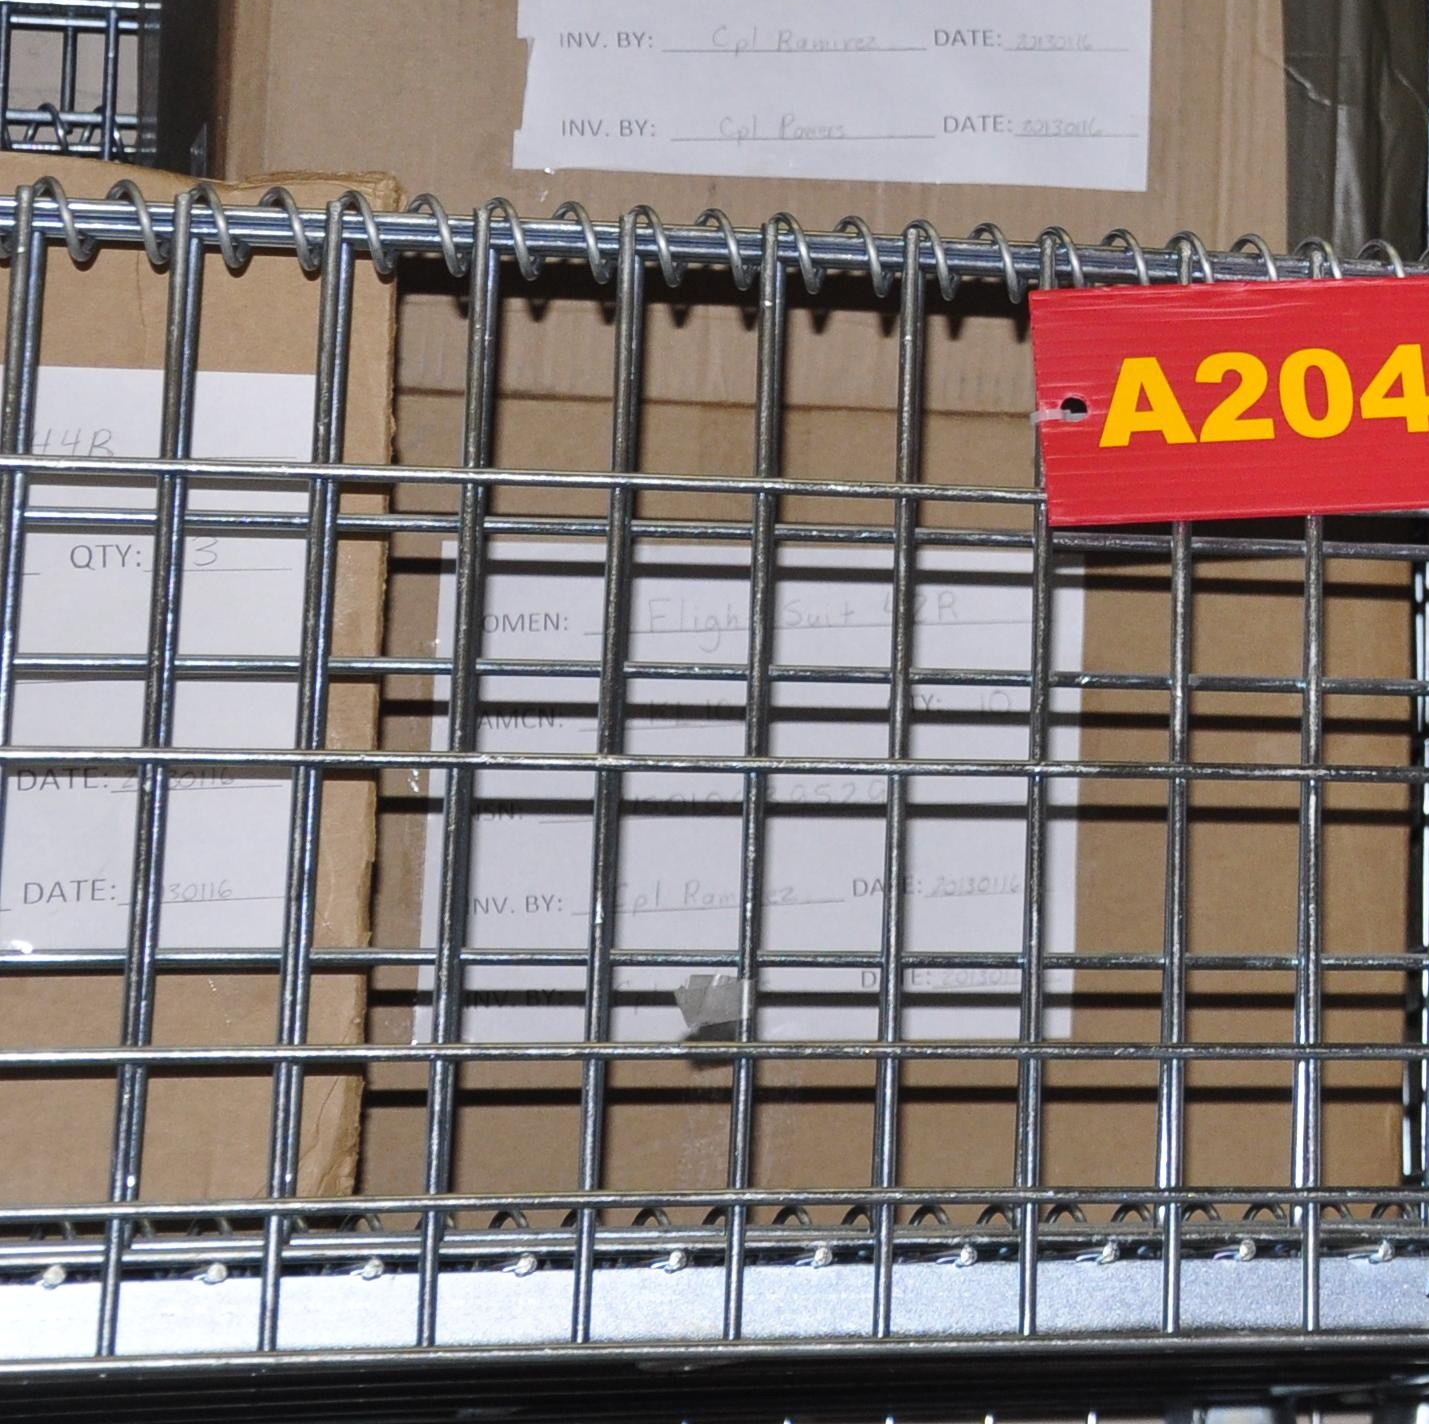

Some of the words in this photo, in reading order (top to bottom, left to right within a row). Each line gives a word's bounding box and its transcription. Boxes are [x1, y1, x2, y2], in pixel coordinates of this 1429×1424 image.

[559, 30, 608, 49] INV.
[616, 30, 654, 49] BY:
[711, 24, 758, 58] Cpl
[776, 28, 877, 52] Ramirez
[932, 27, 1003, 48] DATE:
[561, 118, 610, 138] INV.
[618, 118, 656, 138] BY:
[718, 114, 758, 147] Cpl
[941, 113, 1013, 135] DATE:
[69, 543, 142, 570] QTY:
[192, 536, 218, 567] 3
[476, 611, 569, 634] OMEN:
[648, 596, 746, 654] Fligh
[474, 706, 563, 731] AMCN:
[16, 766, 109, 792] DATE:
[23, 878, 117, 905] DATE:
[525, 894, 564, 914] BY:
[851, 877, 923, 898] DAE:
